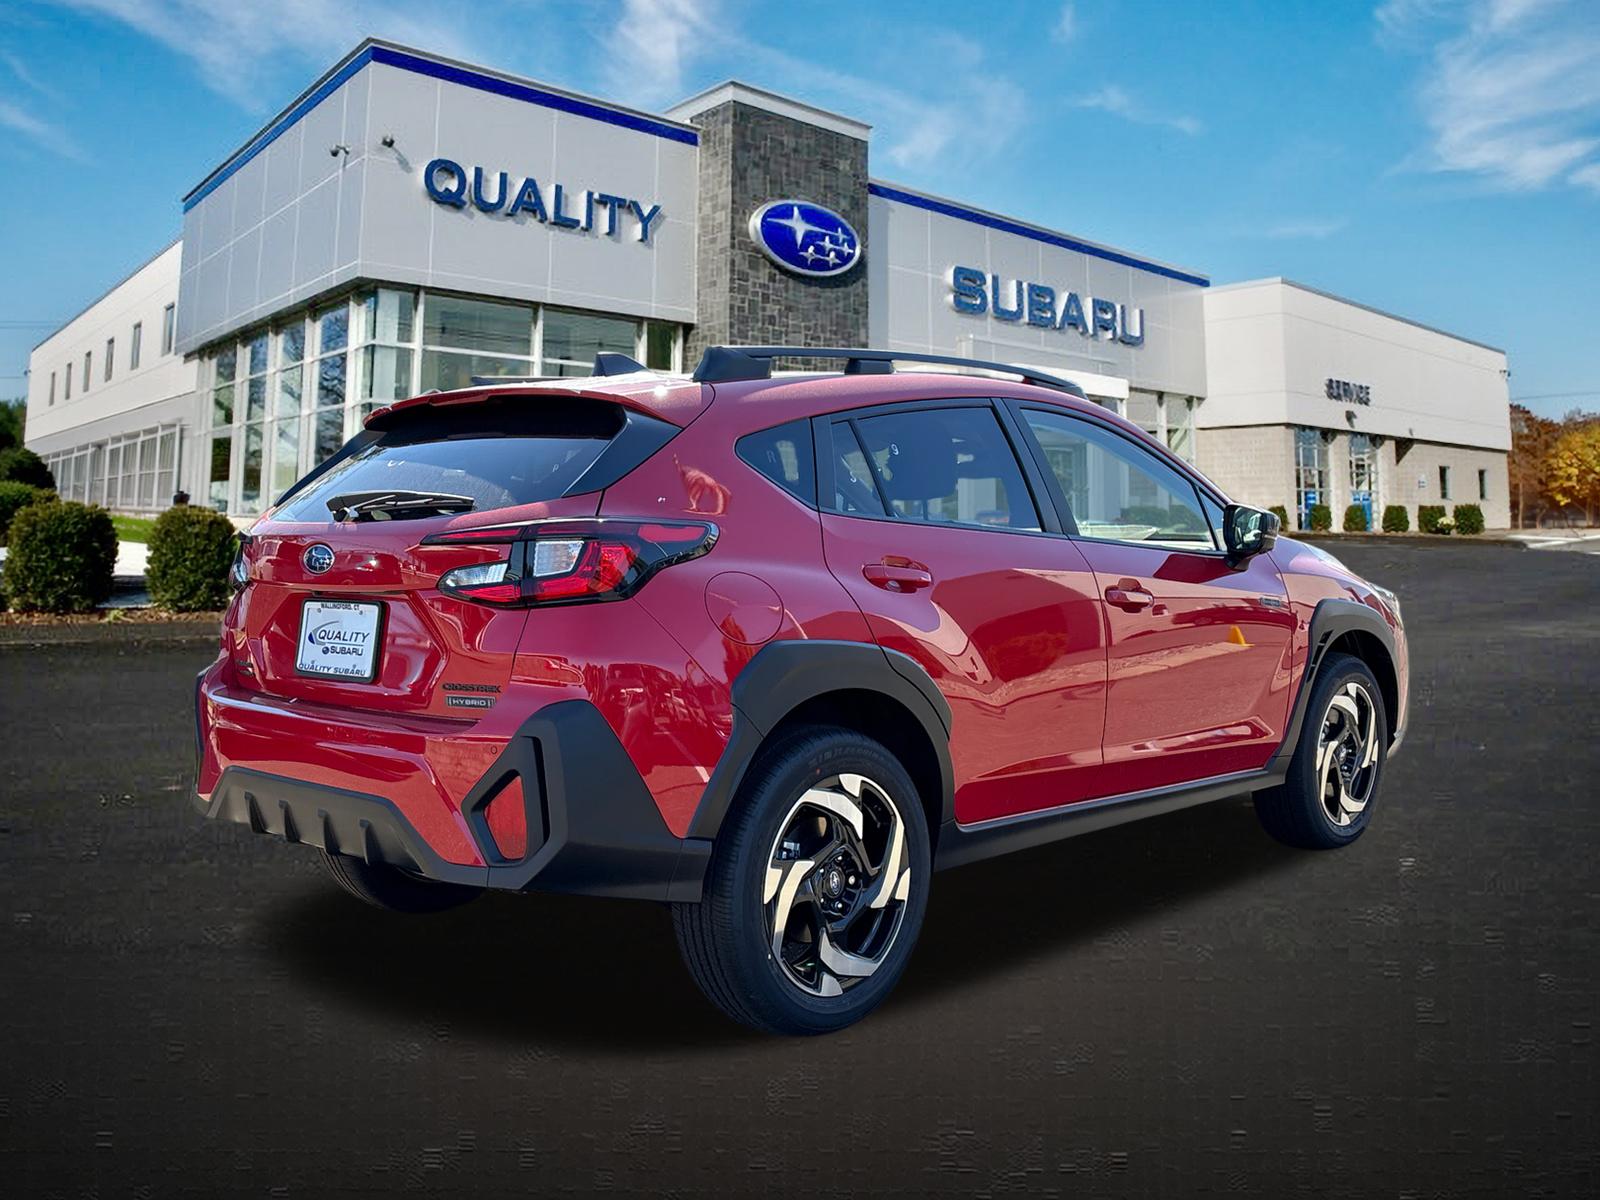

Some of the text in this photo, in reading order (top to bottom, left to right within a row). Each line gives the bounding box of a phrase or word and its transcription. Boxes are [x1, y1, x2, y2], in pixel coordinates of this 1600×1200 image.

[424, 158, 661, 243] QUALITY
[951, 265, 1145, 347] SUBARU
[1325, 378, 1371, 406] SERVICE
[318, 629, 370, 643] QUALITY
[330, 645, 364, 656] SUBARU
[298, 663, 366, 676] QUALITY SUBARU
[442, 683, 501, 693] CROSSTREK
[452, 697, 487, 706] HYBRID
